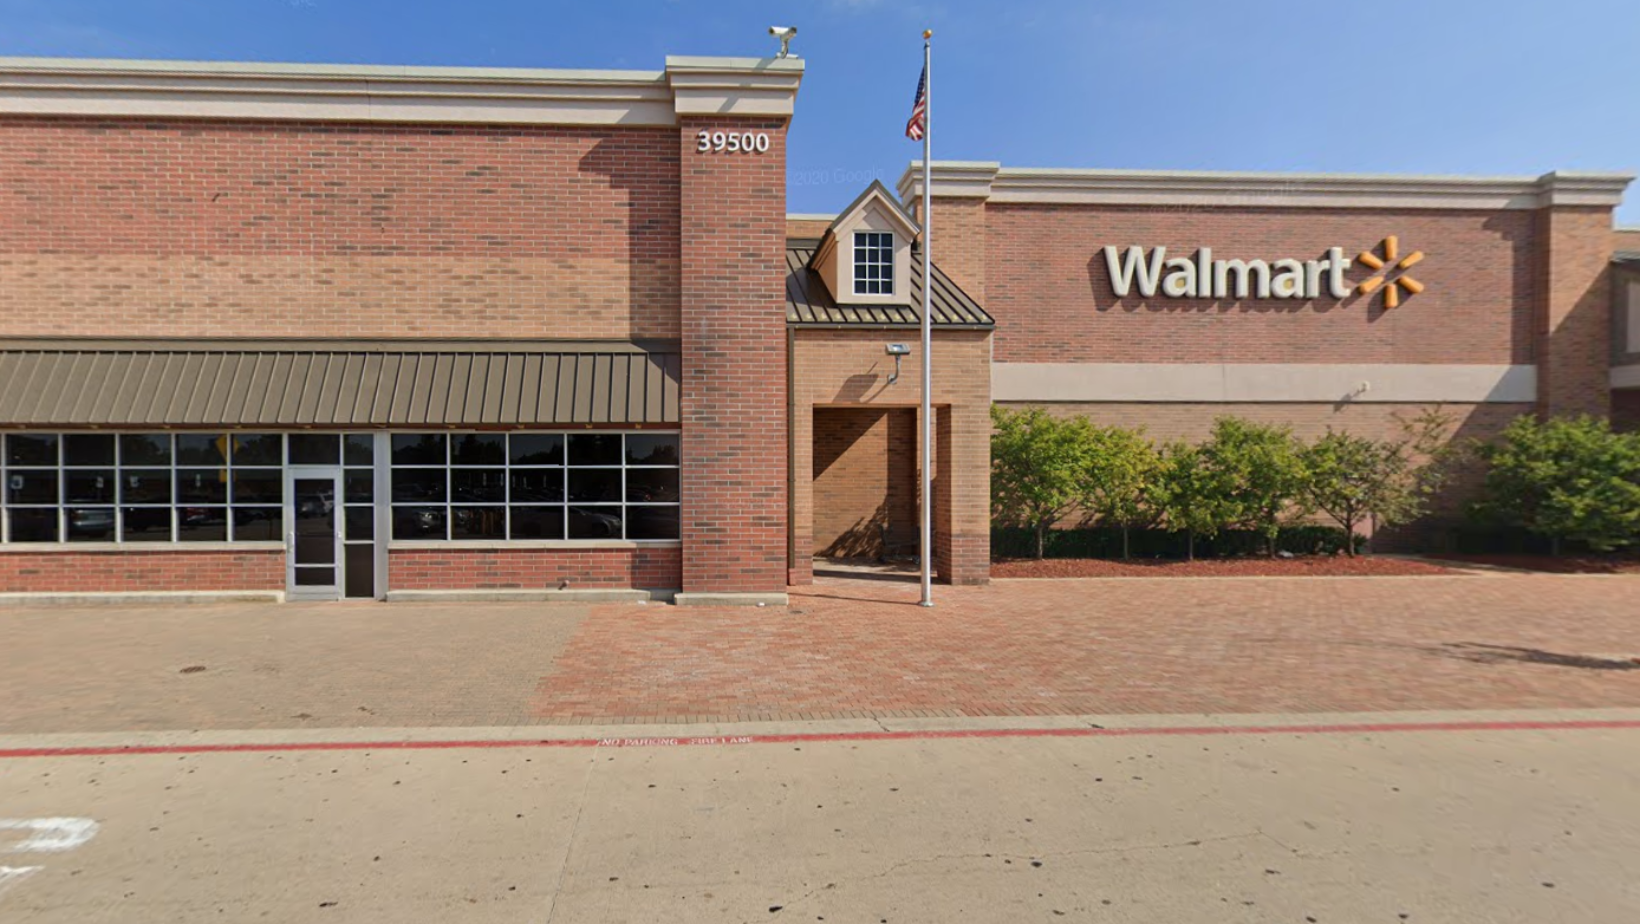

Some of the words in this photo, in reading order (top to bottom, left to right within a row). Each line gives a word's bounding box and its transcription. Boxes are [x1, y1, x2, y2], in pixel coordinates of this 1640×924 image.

[697, 131, 769, 153] 39500
[1103, 245, 1352, 299] Walmart
[602, 738, 620, 746] NO
[624, 738, 678, 746] PARKING
[691, 737, 717, 745] FIRE
[721, 736, 753, 745] LANE
